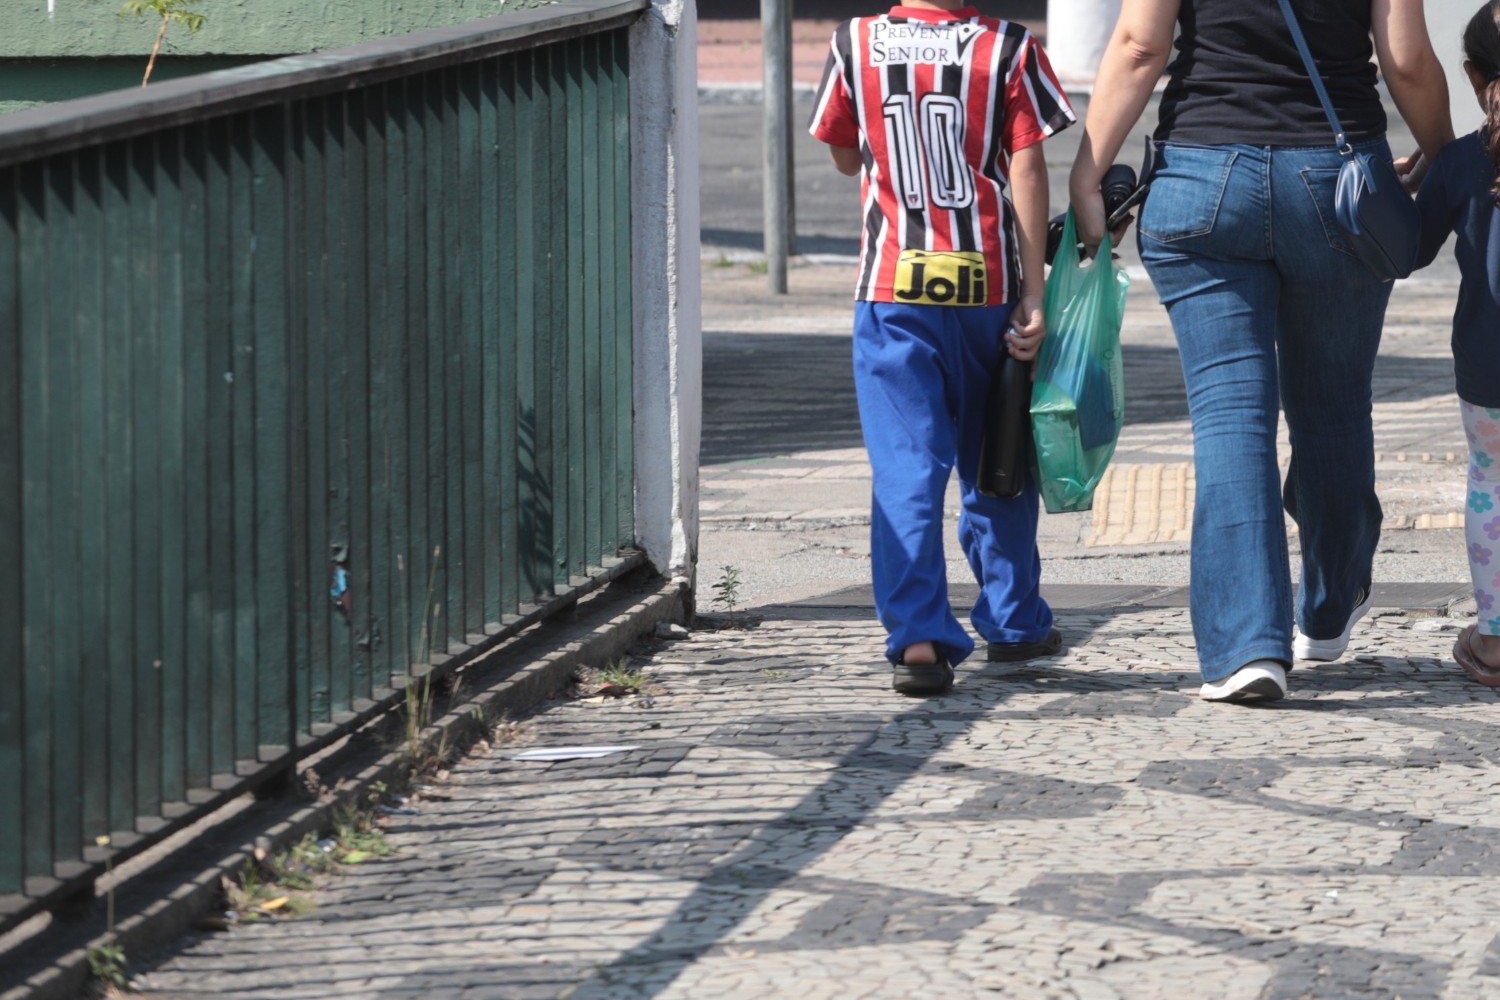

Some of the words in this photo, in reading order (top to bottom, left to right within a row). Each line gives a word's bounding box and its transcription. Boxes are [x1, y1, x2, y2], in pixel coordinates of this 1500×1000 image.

[873, 21, 952, 41] PREVENT
[873, 42, 950, 63] SENIOR
[883, 92, 974, 211] 10
[896, 262, 985, 304] Joli
